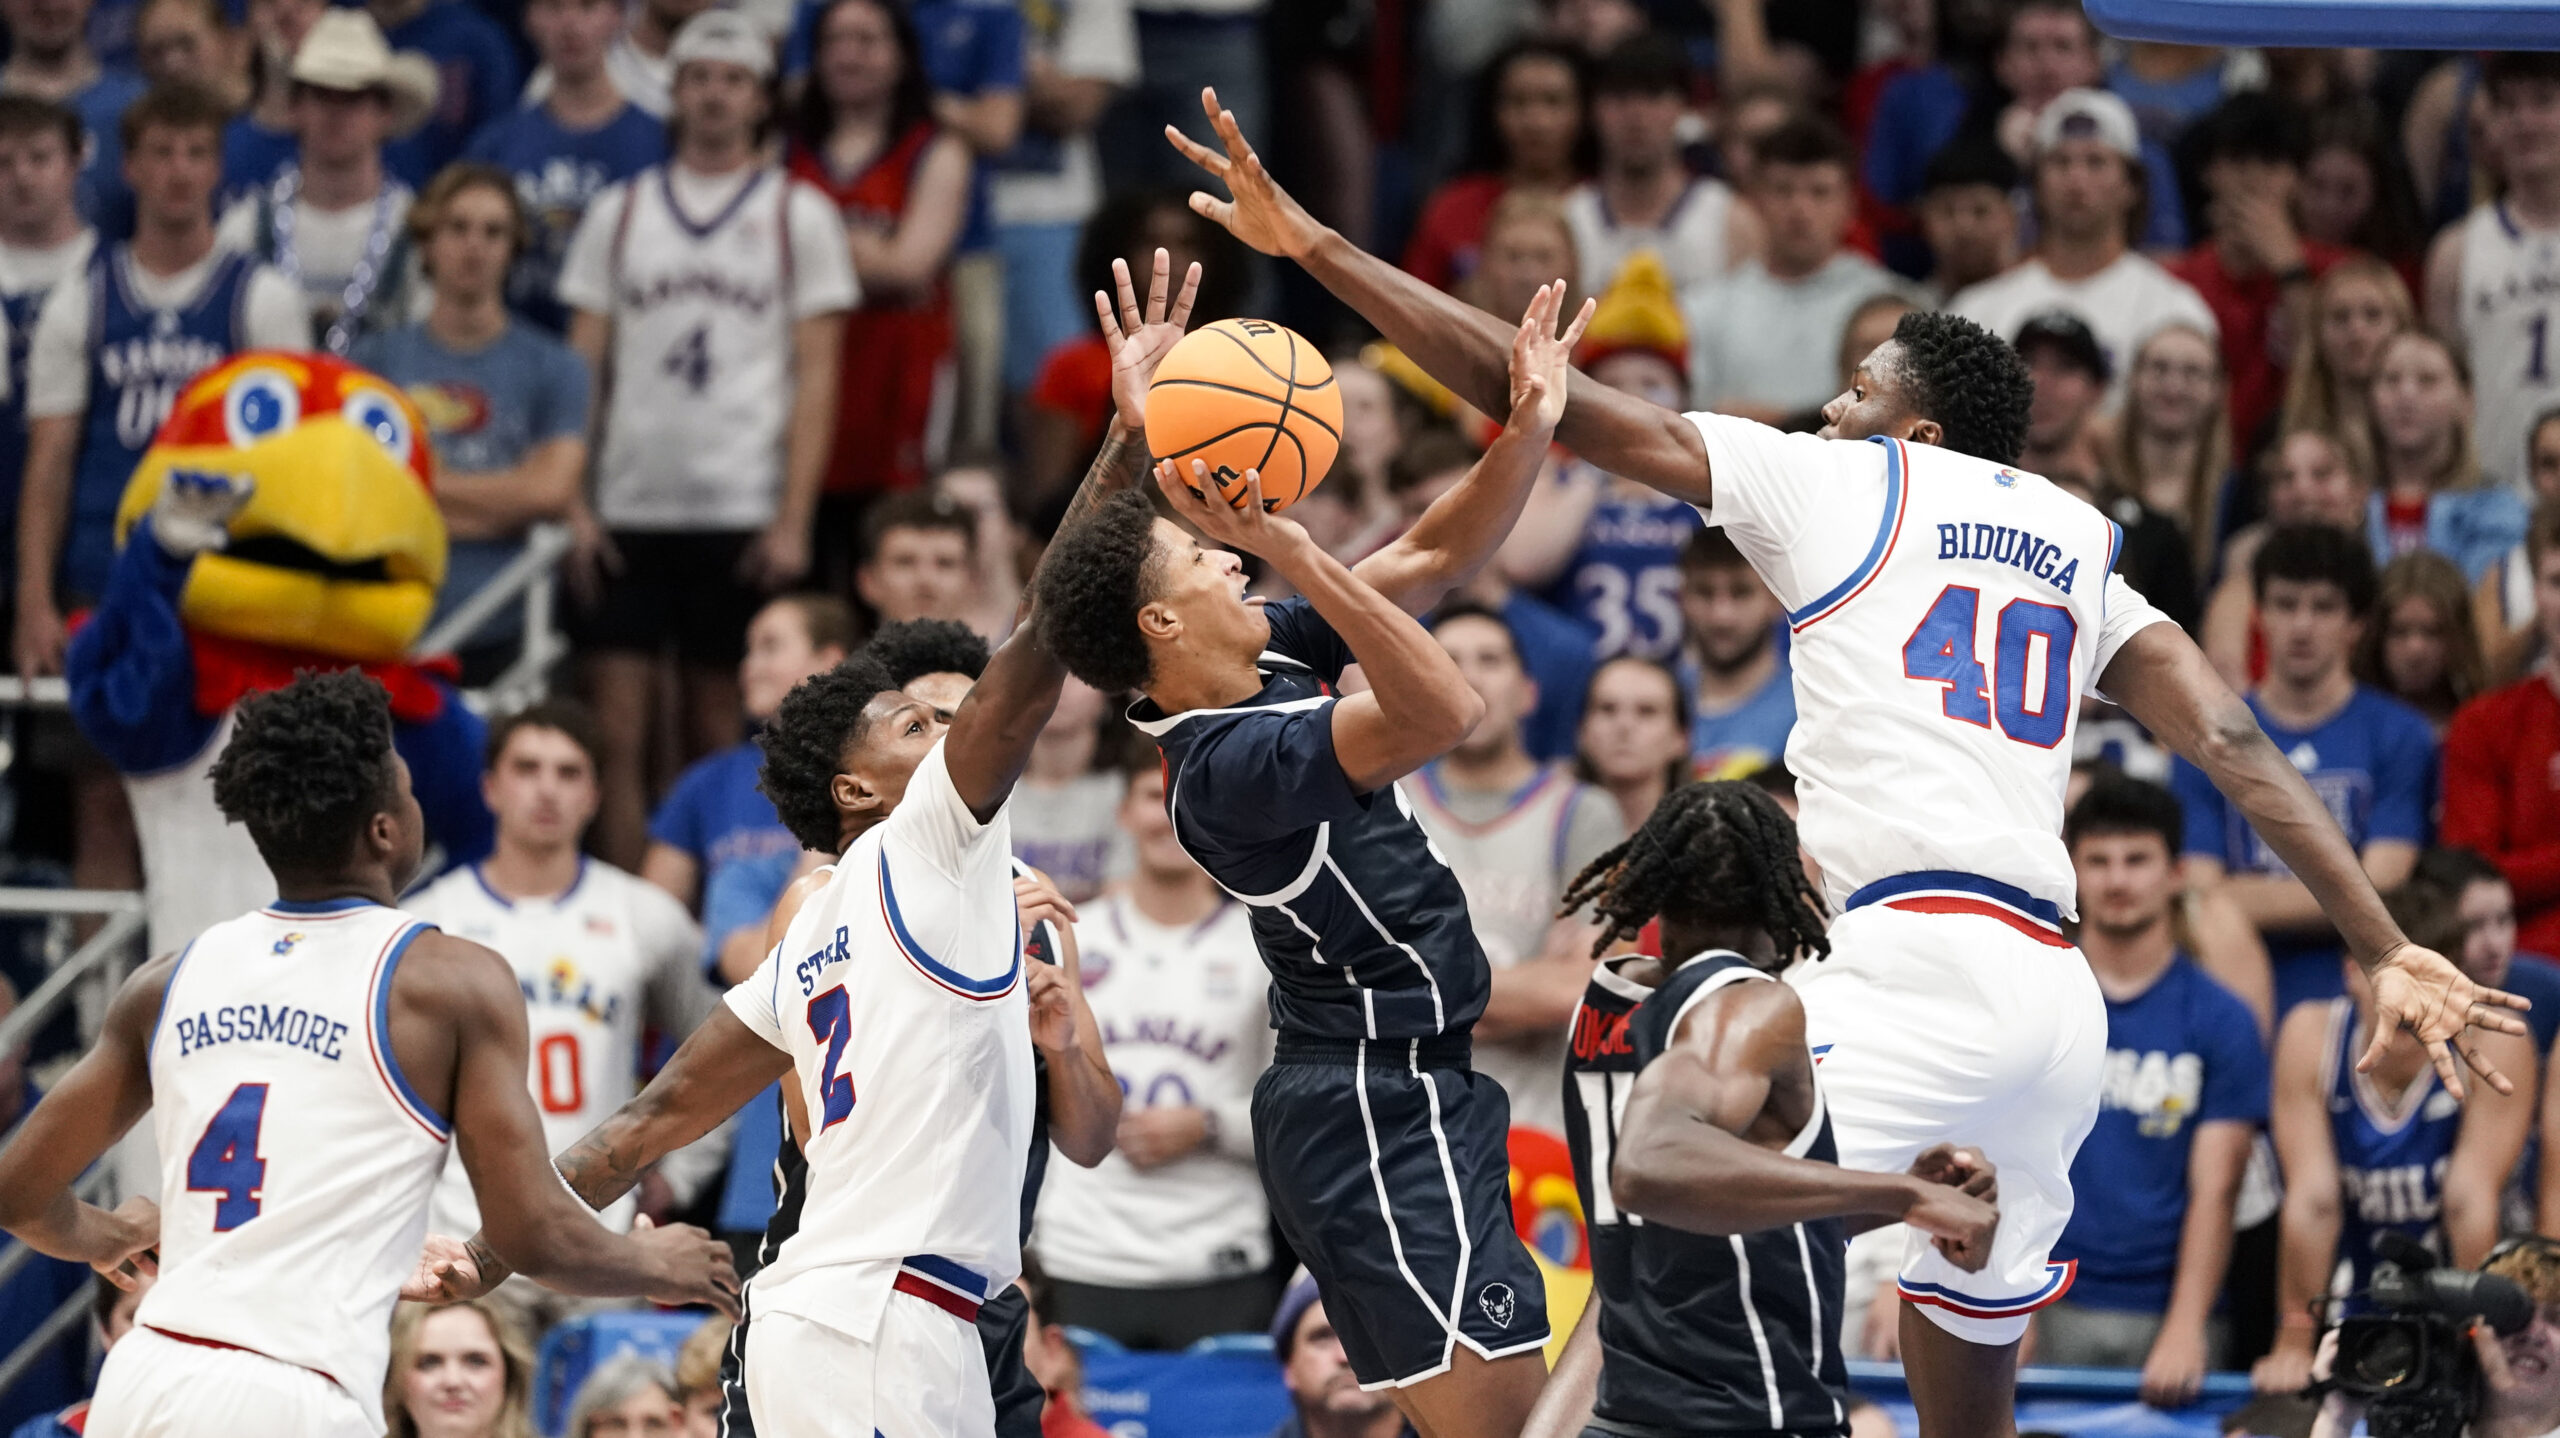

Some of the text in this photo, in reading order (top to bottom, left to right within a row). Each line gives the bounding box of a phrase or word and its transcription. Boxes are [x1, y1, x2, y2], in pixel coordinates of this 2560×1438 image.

[663, 323, 711, 395] 4
[1937, 523, 2079, 595] BIDUNGA
[1576, 562, 1684, 660] 35
[1902, 584, 2078, 749] 40
[176, 1004, 348, 1061] PASSMORE
[538, 1033, 583, 1114] 0
[807, 984, 856, 1136] 2
[186, 1082, 270, 1232] 4
